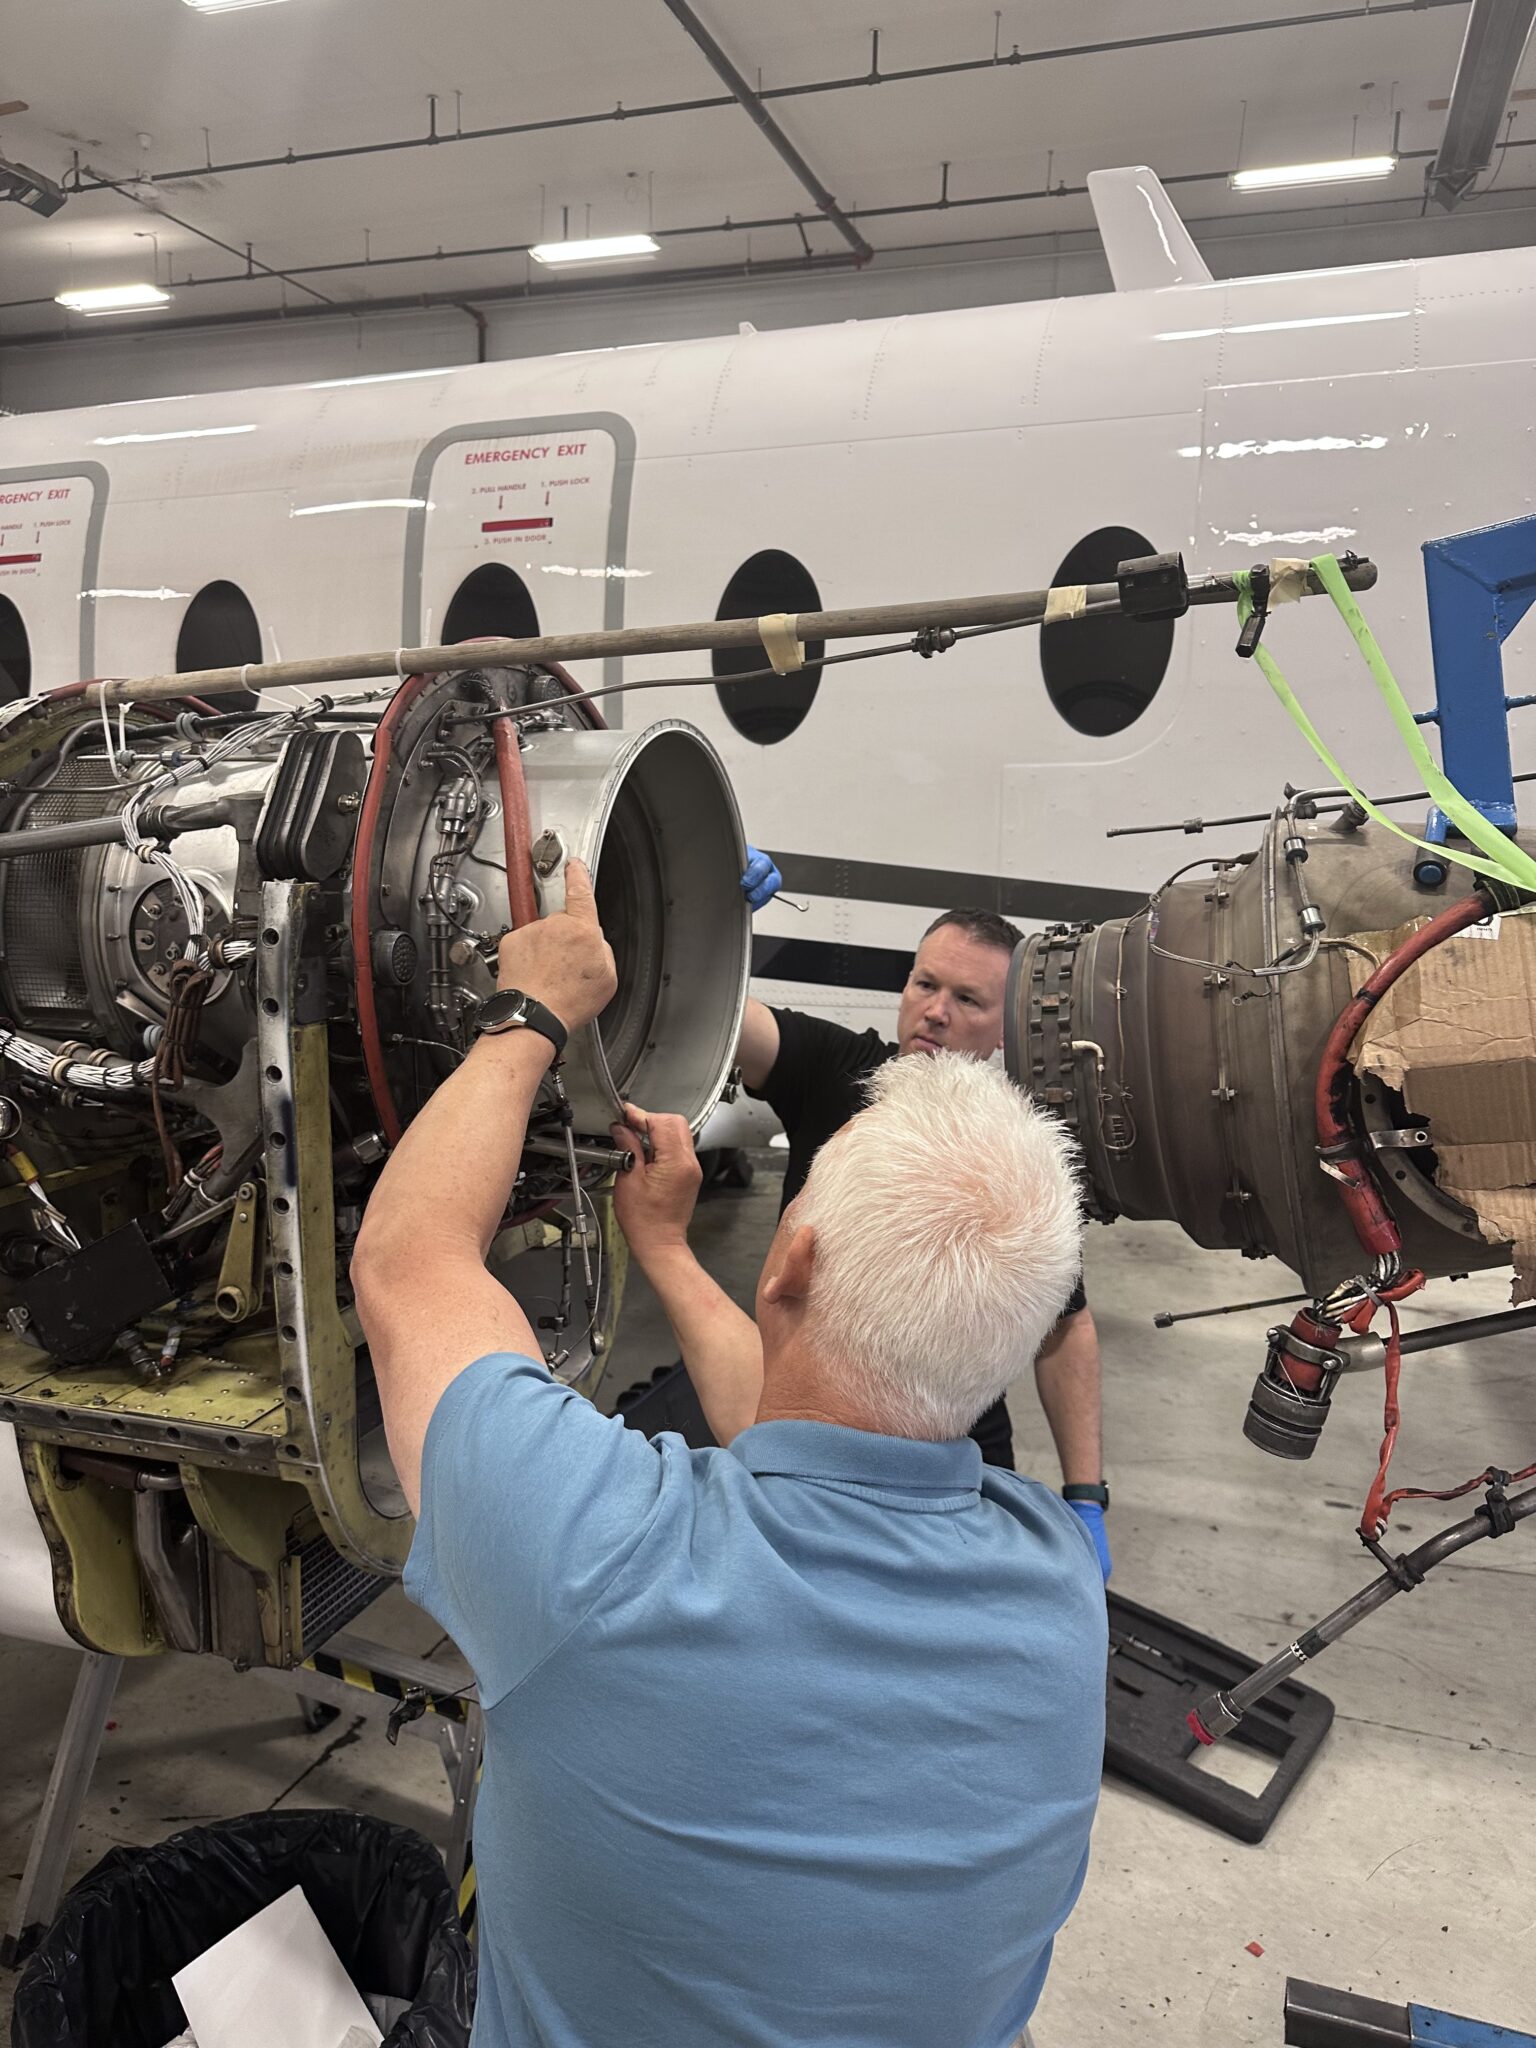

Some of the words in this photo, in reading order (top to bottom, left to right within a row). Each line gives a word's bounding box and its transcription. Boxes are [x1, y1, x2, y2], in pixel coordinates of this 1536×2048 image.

[464, 447, 550, 465] EMERGENCY
[557, 444, 587, 457] EXIT
[549, 479, 569, 488] PUSH
[570, 477, 590, 486] LOCK
[480, 485, 496, 494] PULL
[497, 483, 527, 493] HANDLE
[48, 489, 71, 500] EXIT
[493, 536, 513, 544] PUSH
[524, 534, 547, 542] DOOR
